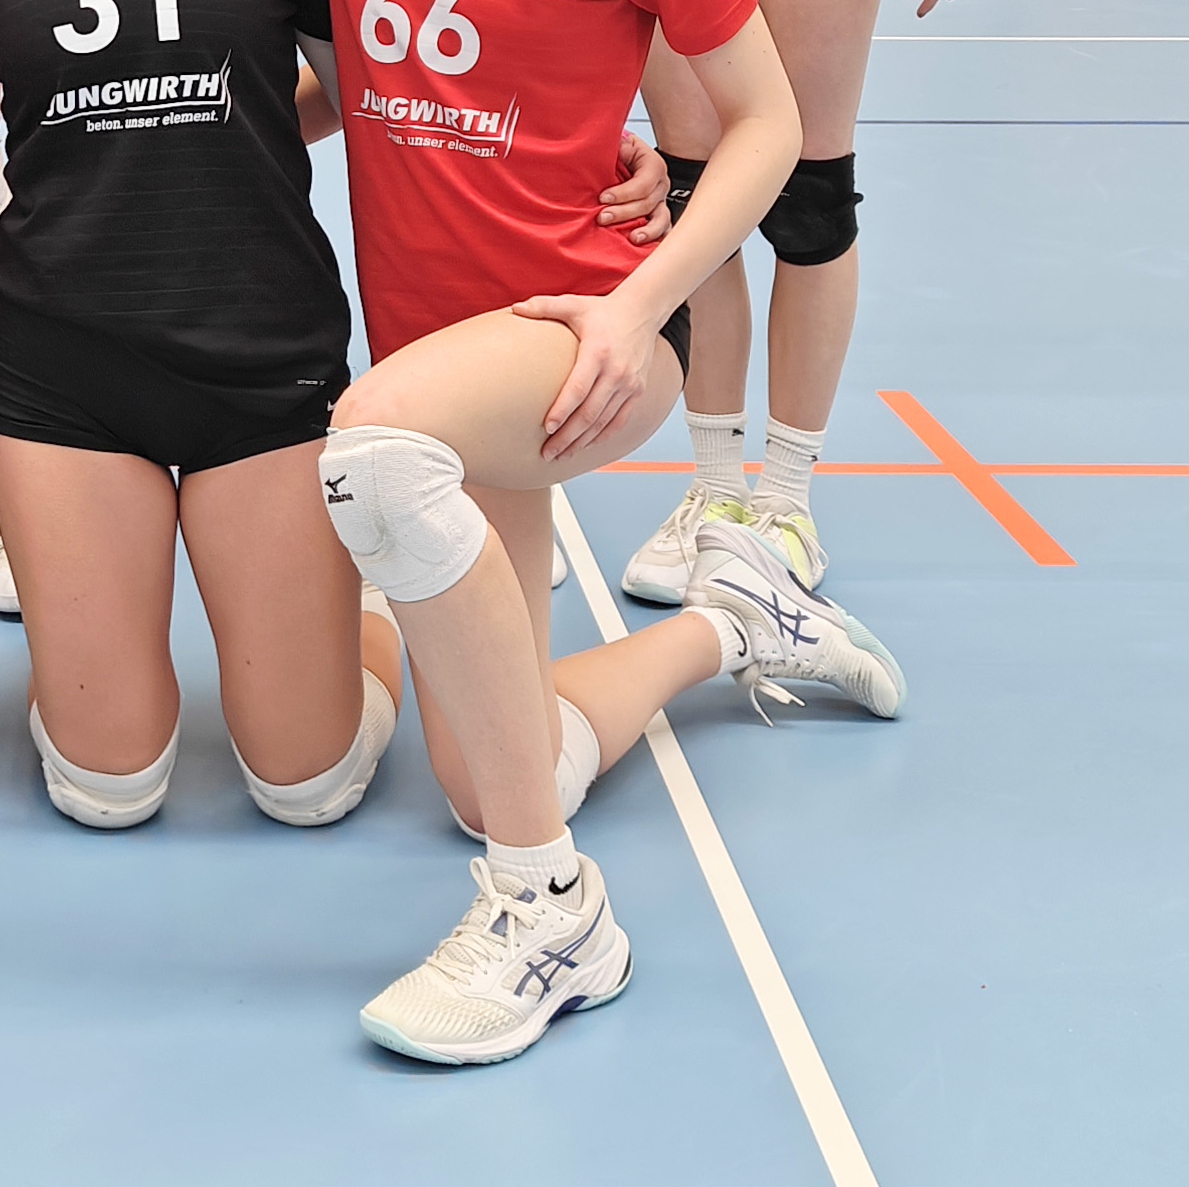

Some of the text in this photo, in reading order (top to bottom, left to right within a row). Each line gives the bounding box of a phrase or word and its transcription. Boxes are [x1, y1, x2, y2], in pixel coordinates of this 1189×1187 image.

[86, 110, 219, 132] beton. unser element.
[407, 135, 446, 148] unser
[447, 139, 498, 157] element.
